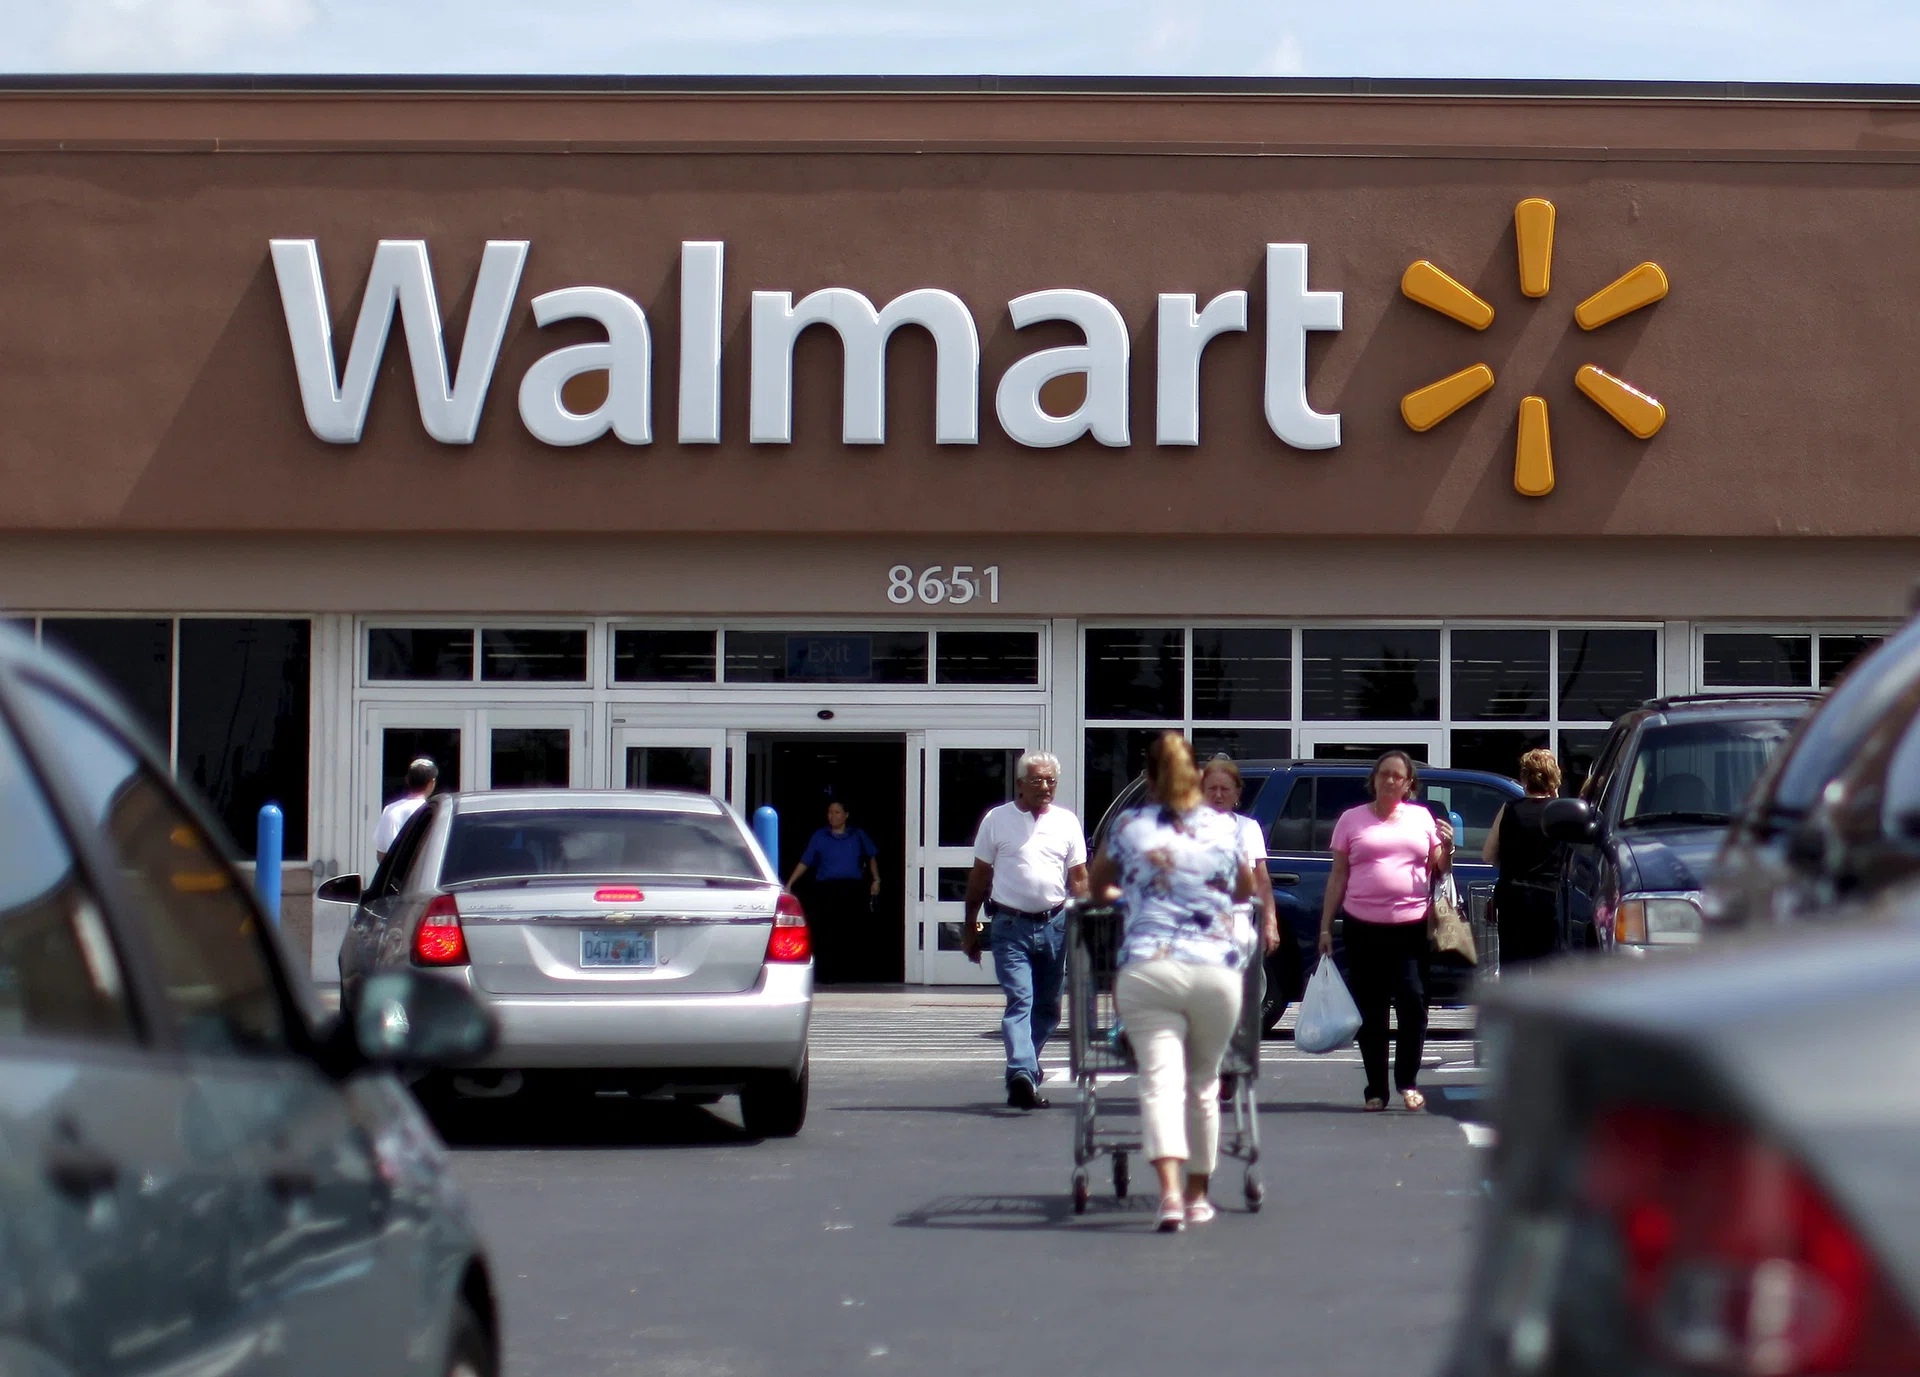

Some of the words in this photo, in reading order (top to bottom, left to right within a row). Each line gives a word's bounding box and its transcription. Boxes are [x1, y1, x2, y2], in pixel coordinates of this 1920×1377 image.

[269, 239, 1344, 450] Walmart
[887, 565, 998, 604] 8651
[808, 641, 850, 662] Exit
